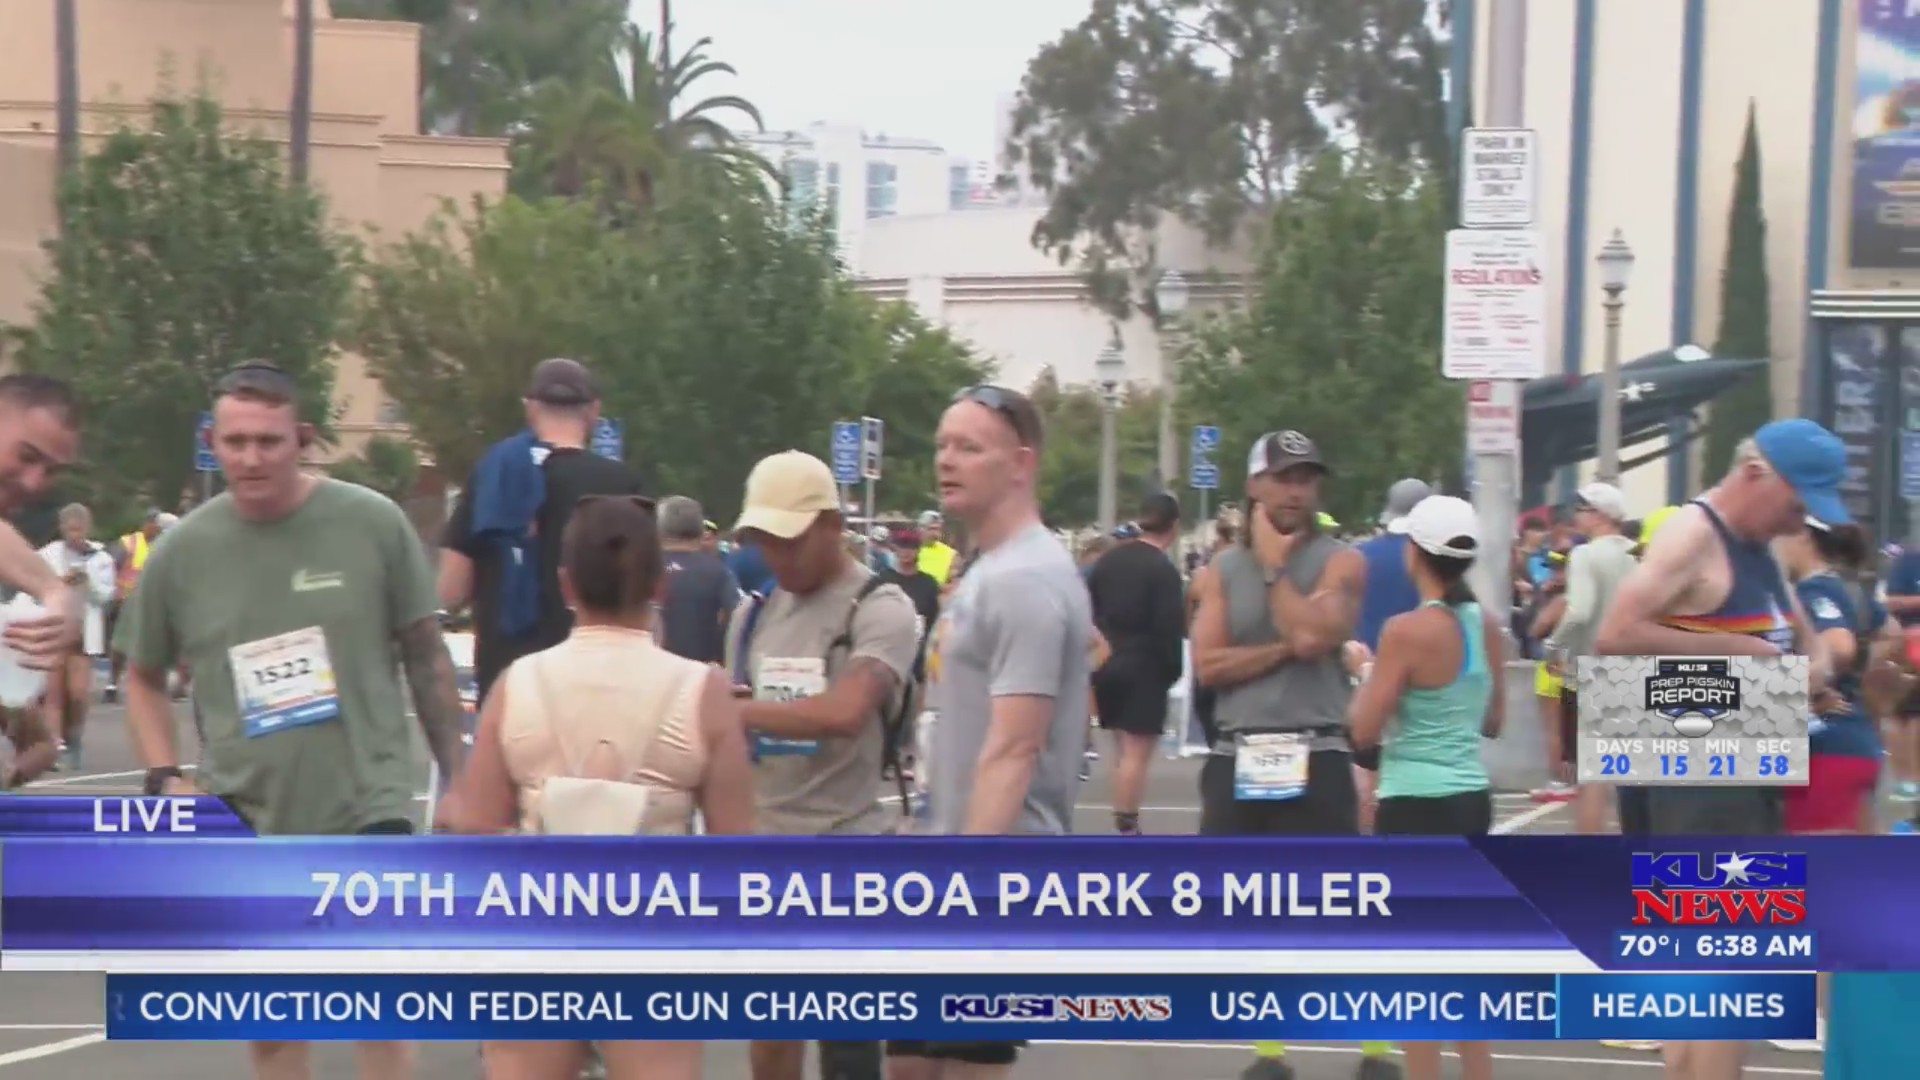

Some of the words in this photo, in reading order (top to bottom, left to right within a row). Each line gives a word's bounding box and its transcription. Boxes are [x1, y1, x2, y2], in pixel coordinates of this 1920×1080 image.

[1474, 136, 1508, 150] PARK
[1452, 268, 1543, 285] REGULATIONS
[253, 657, 313, 686] 1522
